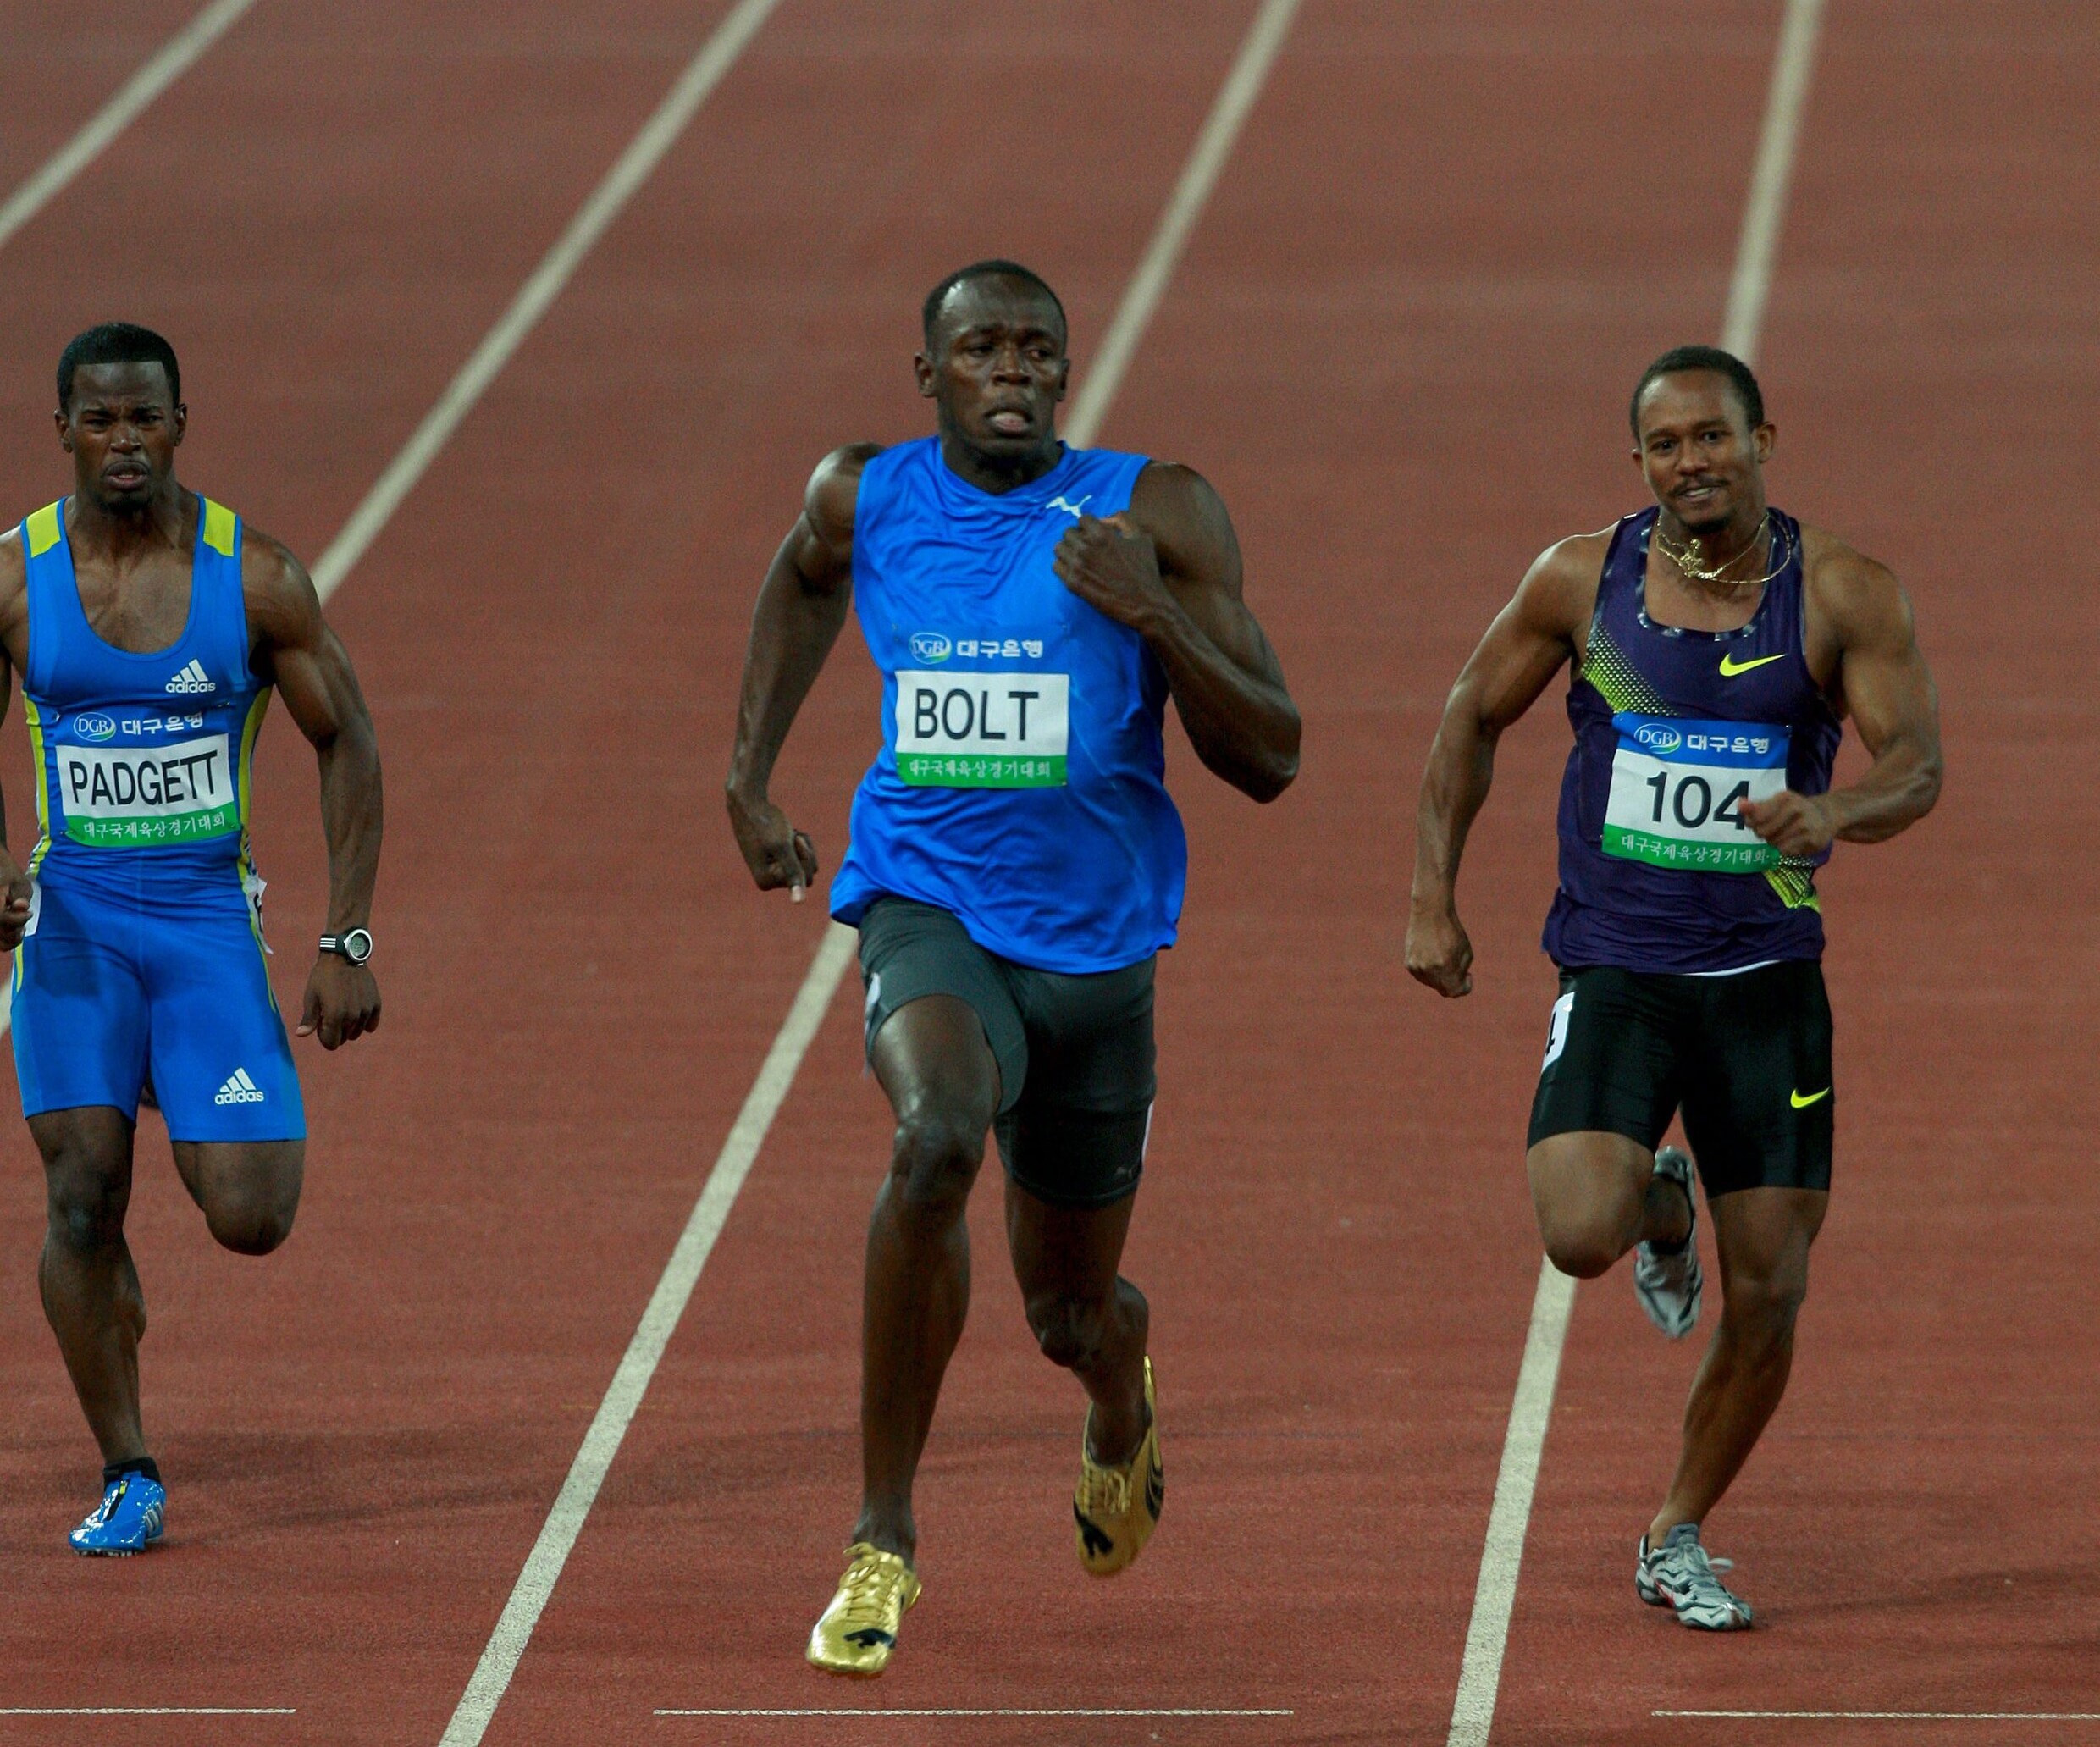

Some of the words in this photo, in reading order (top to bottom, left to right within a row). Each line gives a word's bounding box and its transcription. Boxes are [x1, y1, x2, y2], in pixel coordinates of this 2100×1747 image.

[956, 639, 1044, 659] 대구은행
[165, 680, 216, 694] adidas
[77, 717, 110, 733] DGB
[121, 712, 203, 736] 대구은행
[915, 688, 1040, 741] BOLT
[1639, 729, 1673, 746] DGB
[1687, 734, 1770, 754] 대구은행
[69, 749, 218, 806] PADGETT
[1646, 771, 1750, 831] 104
[83, 811, 225, 838] 대구국제육상경기대회
[1621, 834, 1766, 864] 대구국제육상경기대회
[214, 1089, 264, 1105] adidas
